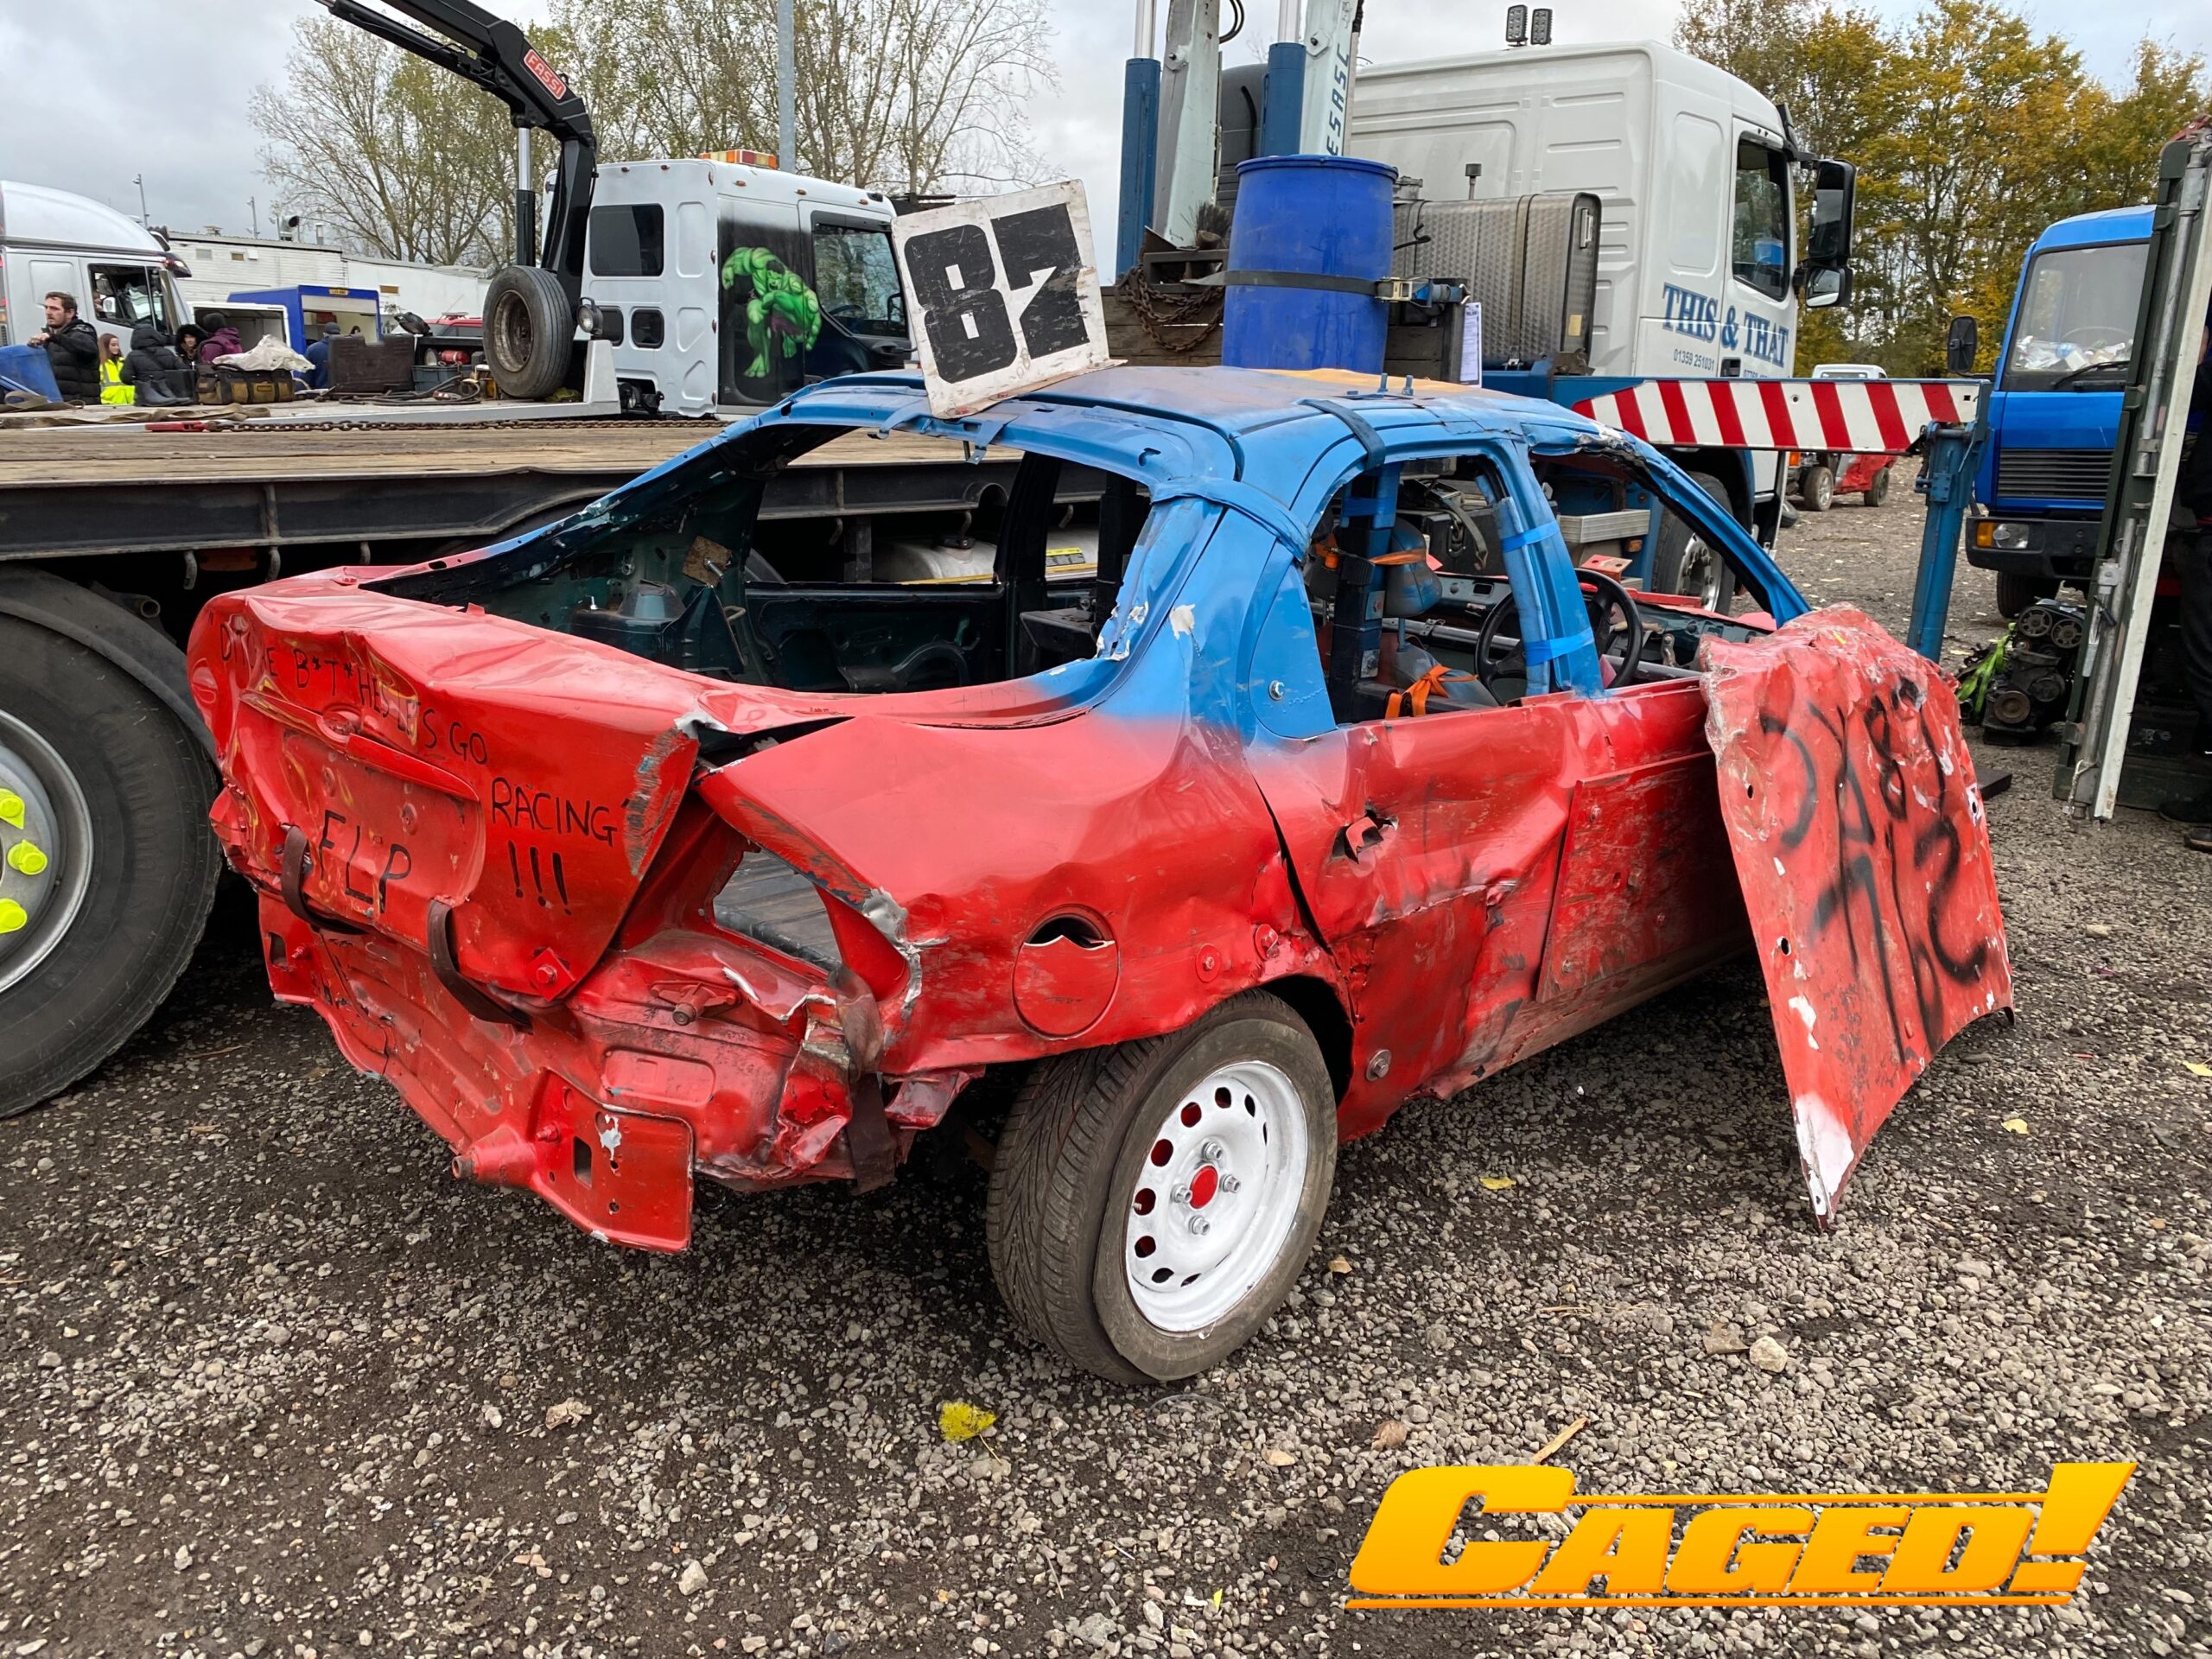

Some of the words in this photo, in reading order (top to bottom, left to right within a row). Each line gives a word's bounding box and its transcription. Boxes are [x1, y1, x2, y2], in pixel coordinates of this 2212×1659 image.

[527, 54, 563, 95] FASSI
[1662, 282, 1718, 343] THIS
[1720, 305, 1739, 351] &
[1744, 310, 1789, 368] THAT
[1673, 348, 1694, 365] 01359
[448, 721, 488, 766] GO
